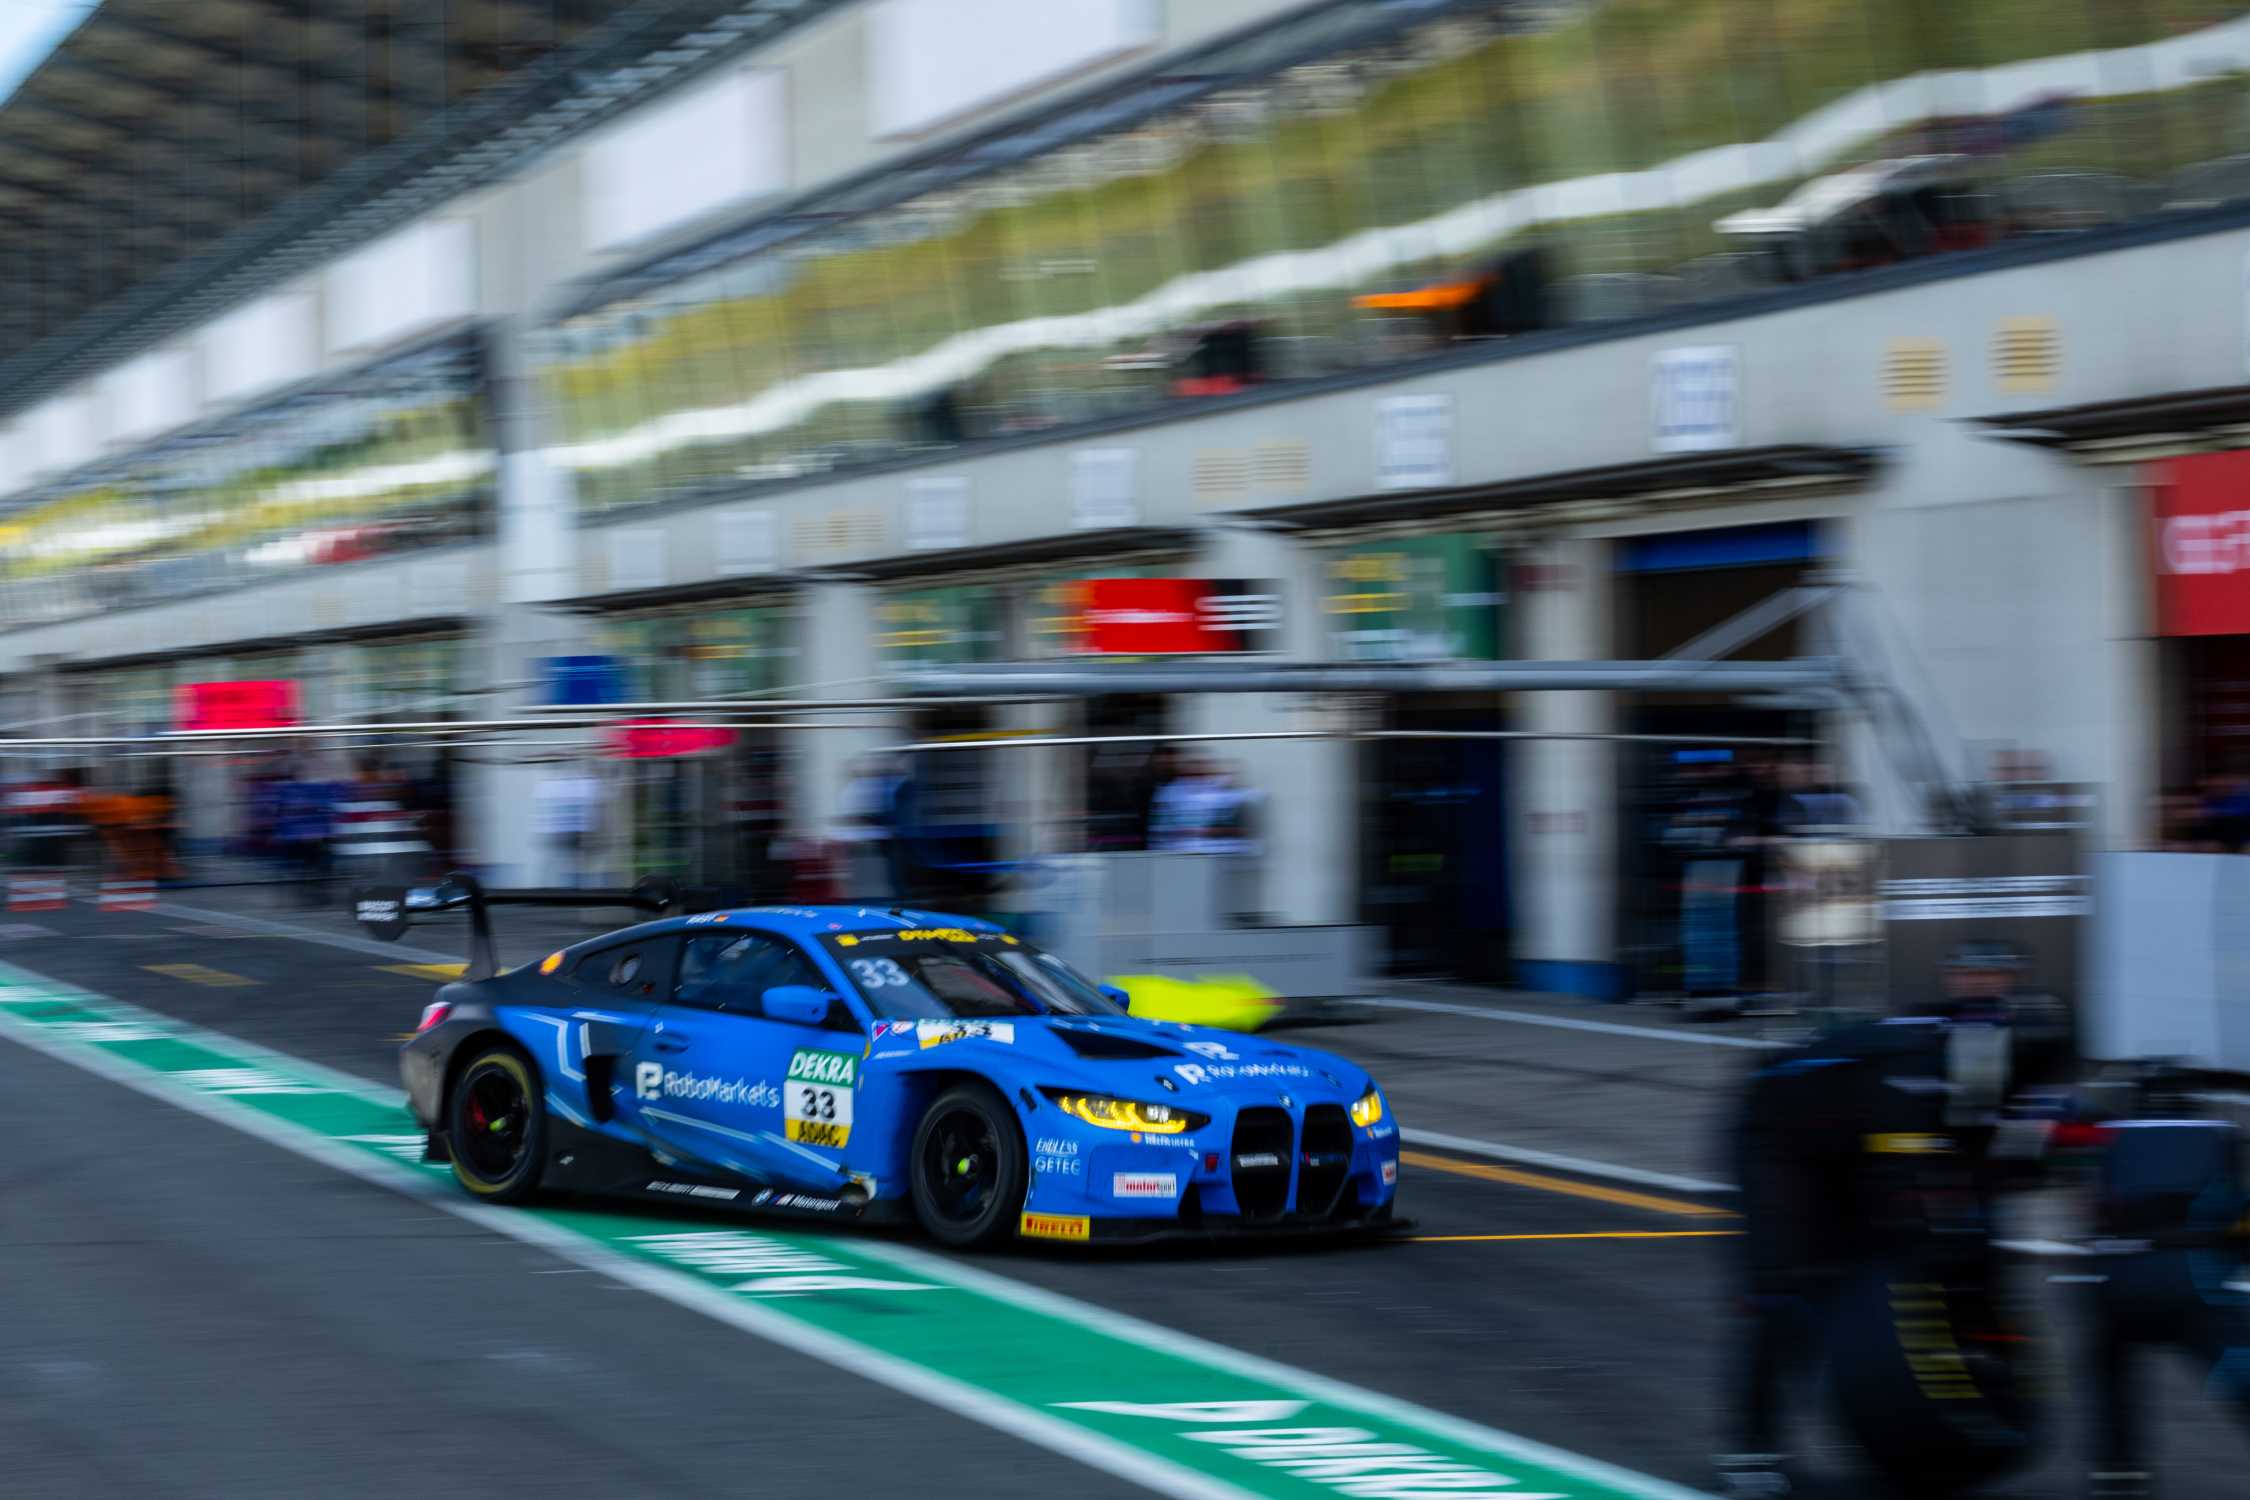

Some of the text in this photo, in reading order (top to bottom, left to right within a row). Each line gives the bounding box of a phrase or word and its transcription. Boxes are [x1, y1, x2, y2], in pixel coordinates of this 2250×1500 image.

[850, 958, 910, 989] 33
[788, 1051, 854, 1084] DEKRA
[664, 1071, 781, 1108] RoboMarkets
[800, 1087, 836, 1120] 33
[1034, 1156, 1081, 1176] GETEC
